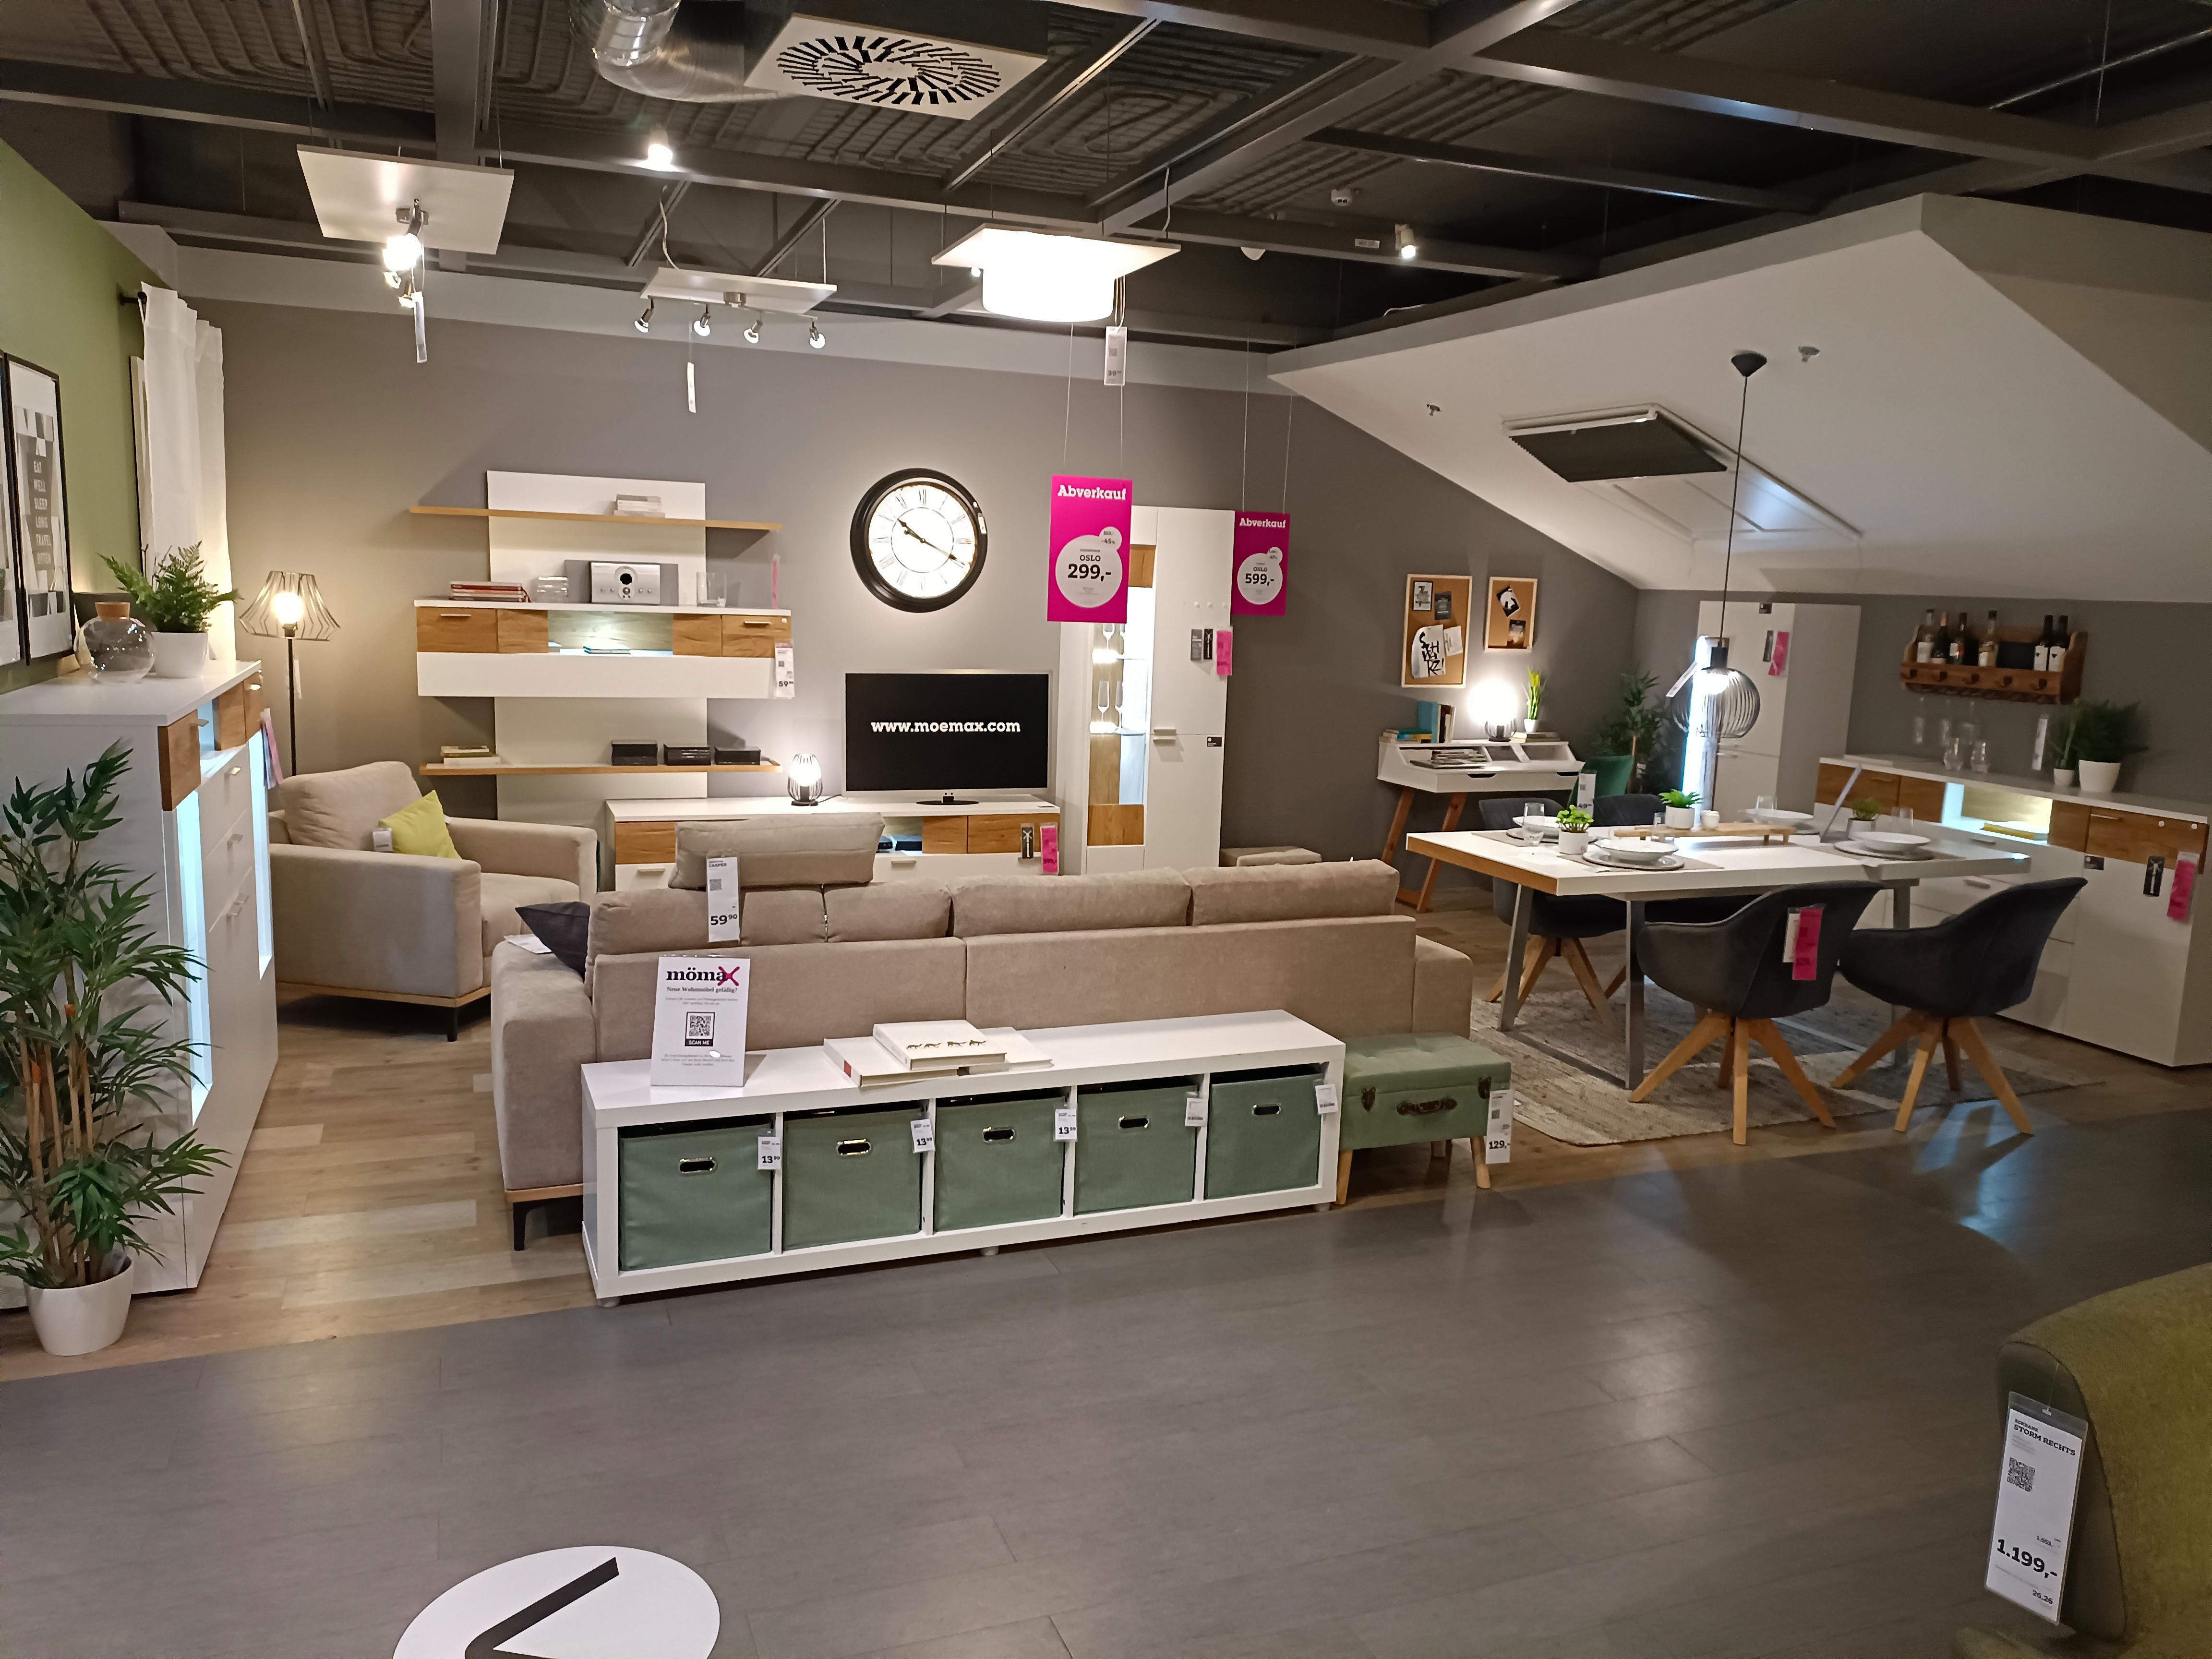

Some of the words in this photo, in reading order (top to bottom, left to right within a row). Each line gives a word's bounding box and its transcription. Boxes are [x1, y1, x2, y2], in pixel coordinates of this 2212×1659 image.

[33, 479, 46, 493] WELL
[1058, 485, 1126, 500] Abverkauf
[36, 516, 48, 529] LONG
[1239, 518, 1286, 528] Abverkauf
[36, 534, 52, 546] TRAVEL
[1068, 564, 1111, 582] 299,-
[1245, 573, 1274, 586] 599,-
[871, 722, 1021, 732] www.moemax.com
[1489, 1140, 1511, 1149] 129,-
[2015, 1419, 2039, 1432] ECKBANK
[2014, 1424, 2042, 1441] STORM
[2043, 1437, 2076, 1456] RECHTS
[1997, 1539, 2057, 1578] 1.199,-
